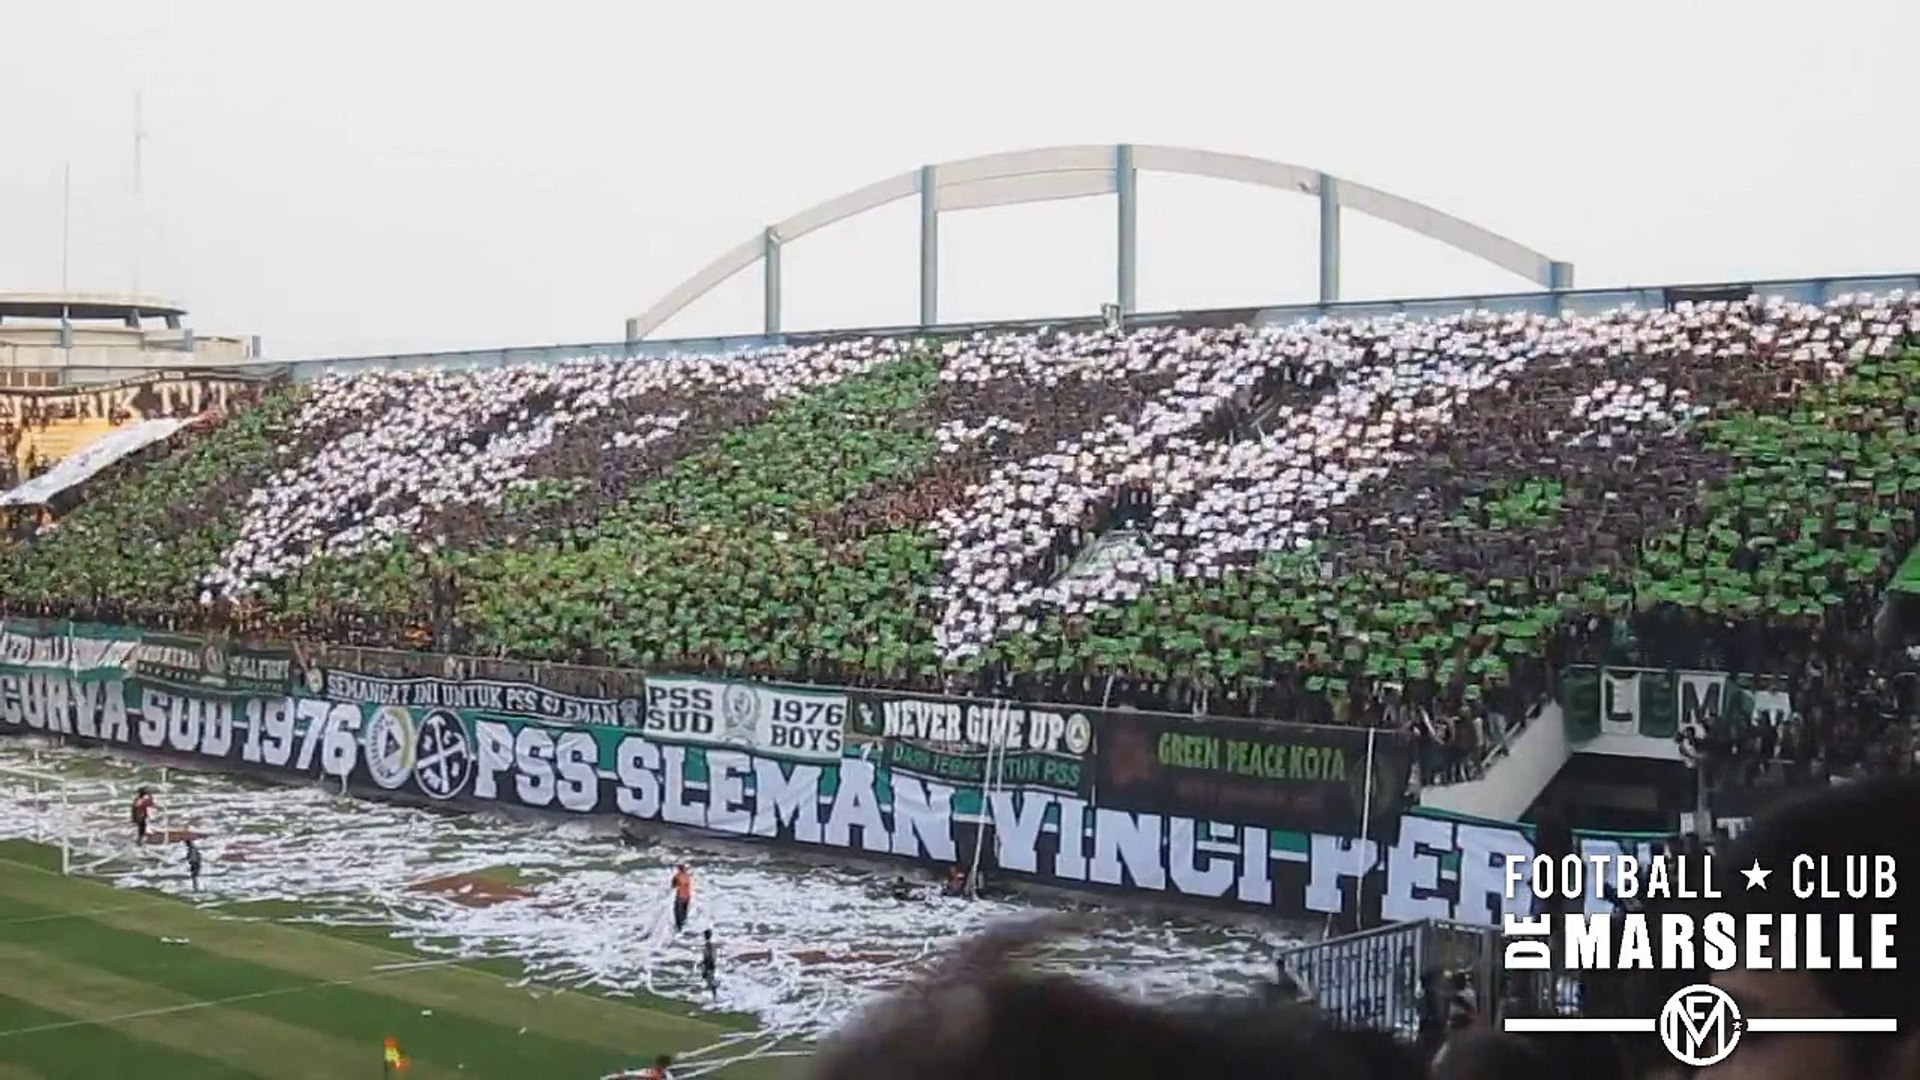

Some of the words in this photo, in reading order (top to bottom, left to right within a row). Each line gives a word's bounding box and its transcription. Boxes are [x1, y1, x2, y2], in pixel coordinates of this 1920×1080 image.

[327, 673, 412, 704] SEMANGAT
[442, 684, 503, 710] UNTUK
[505, 688, 537, 712] PSS
[647, 686, 713, 711] PSS
[645, 710, 713, 735] SUD
[772, 699, 844, 726] 1976
[882, 700, 962, 743] NEVER
[966, 704, 1025, 749] GIVE
[1029, 711, 1066, 752] UP
[770, 724, 843, 753] BOYS
[1157, 731, 1219, 770] GREEN
[1226, 740, 1286, 779] PEACE
[1289, 745, 1347, 782] KOTA
[1043, 759, 1081, 786] PSS
[0, 673, 130, 743] CURVA
[137, 688, 234, 757] SUD
[242, 696, 363, 775] 1976
[473, 719, 599, 813] PSS
[615, 737, 958, 862] SLEMAN
[989, 790, 1273, 906] VINCI
[1305, 814, 1539, 924] PER
